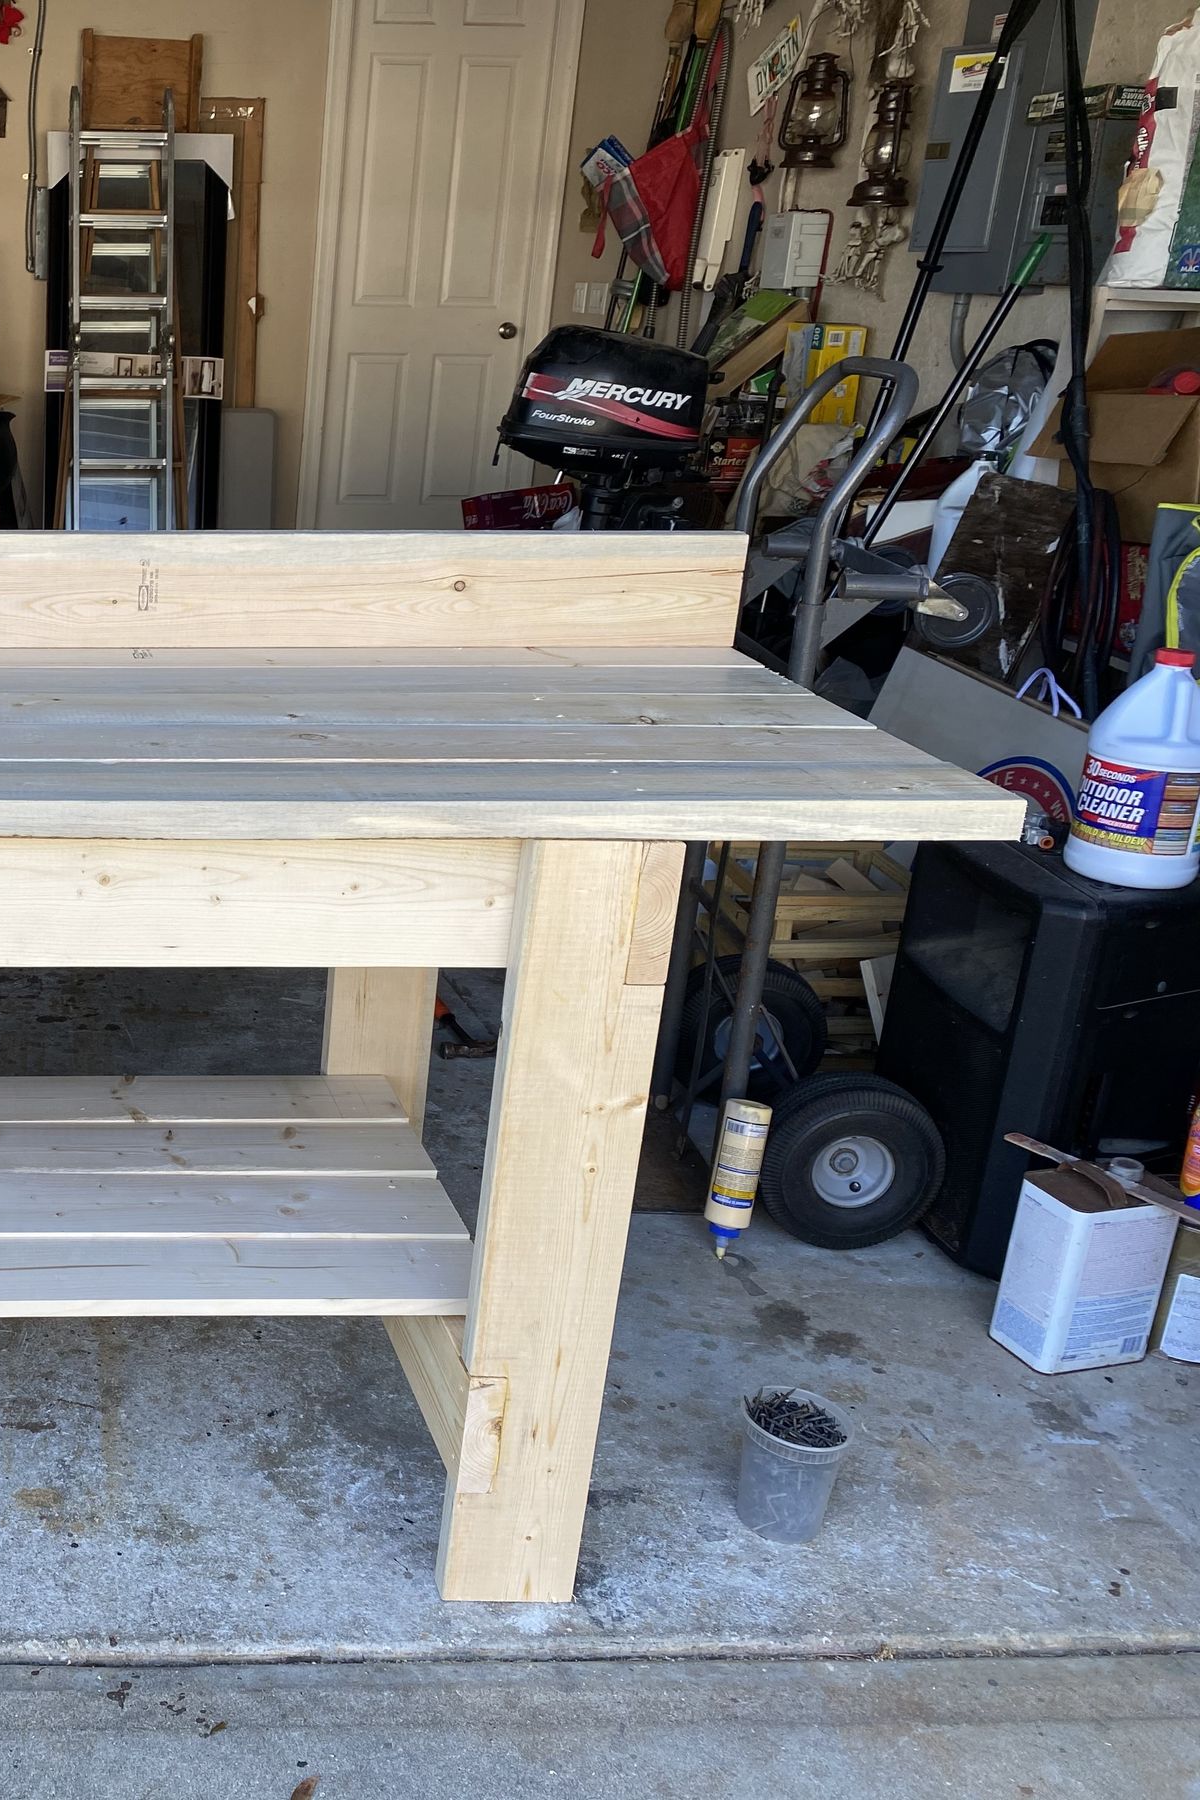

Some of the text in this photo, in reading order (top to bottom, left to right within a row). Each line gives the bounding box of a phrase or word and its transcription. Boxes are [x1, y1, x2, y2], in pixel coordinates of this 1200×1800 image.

[813, 326, 822, 348] 200
[566, 377, 692, 411] MERCURY
[531, 409, 596, 427] FourStroke
[1086, 758, 1138, 784] 30 SECONDS
[1077, 793, 1146, 824] CLEANER
[1107, 832, 1147, 846] MILDEW
